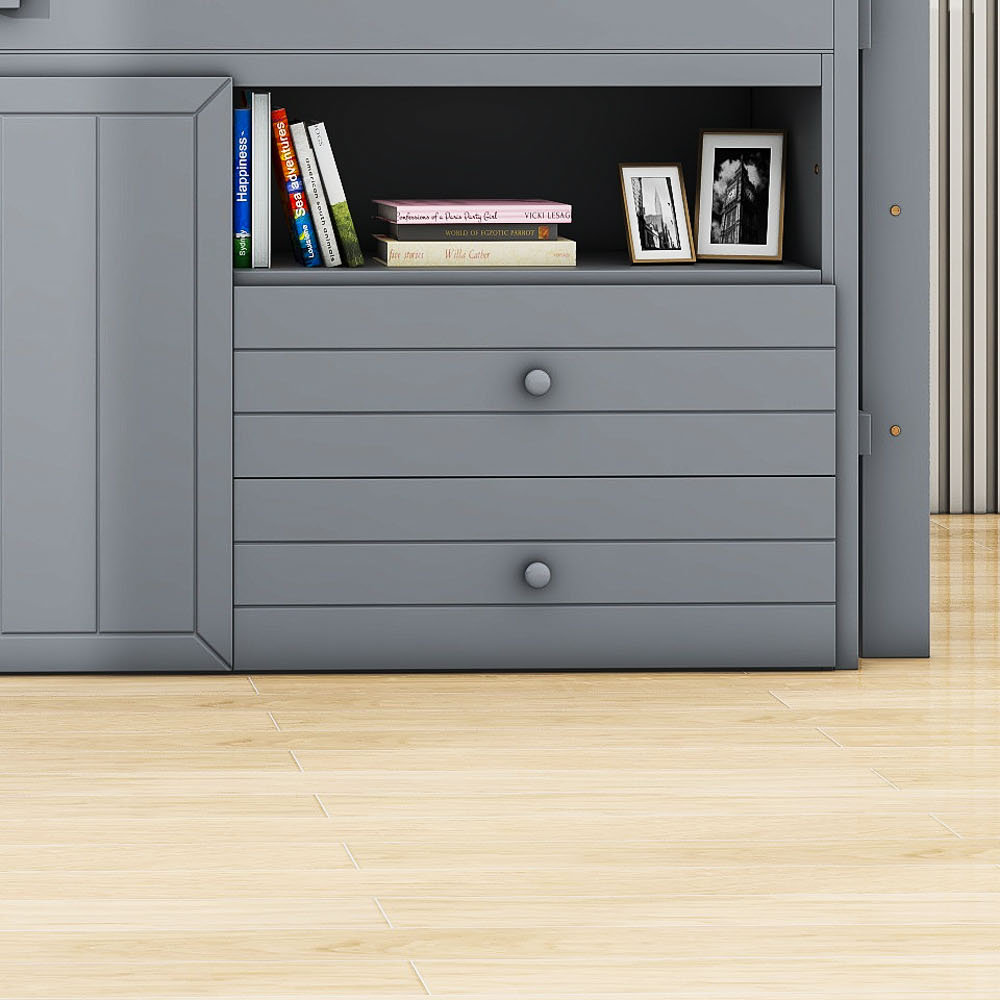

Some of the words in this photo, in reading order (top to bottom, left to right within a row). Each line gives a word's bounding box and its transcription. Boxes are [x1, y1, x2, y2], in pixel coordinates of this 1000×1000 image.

[277, 121, 300, 190] adventures
[294, 193, 307, 219] Sea
[316, 201, 327, 225] south
[323, 227, 336, 263] animals
